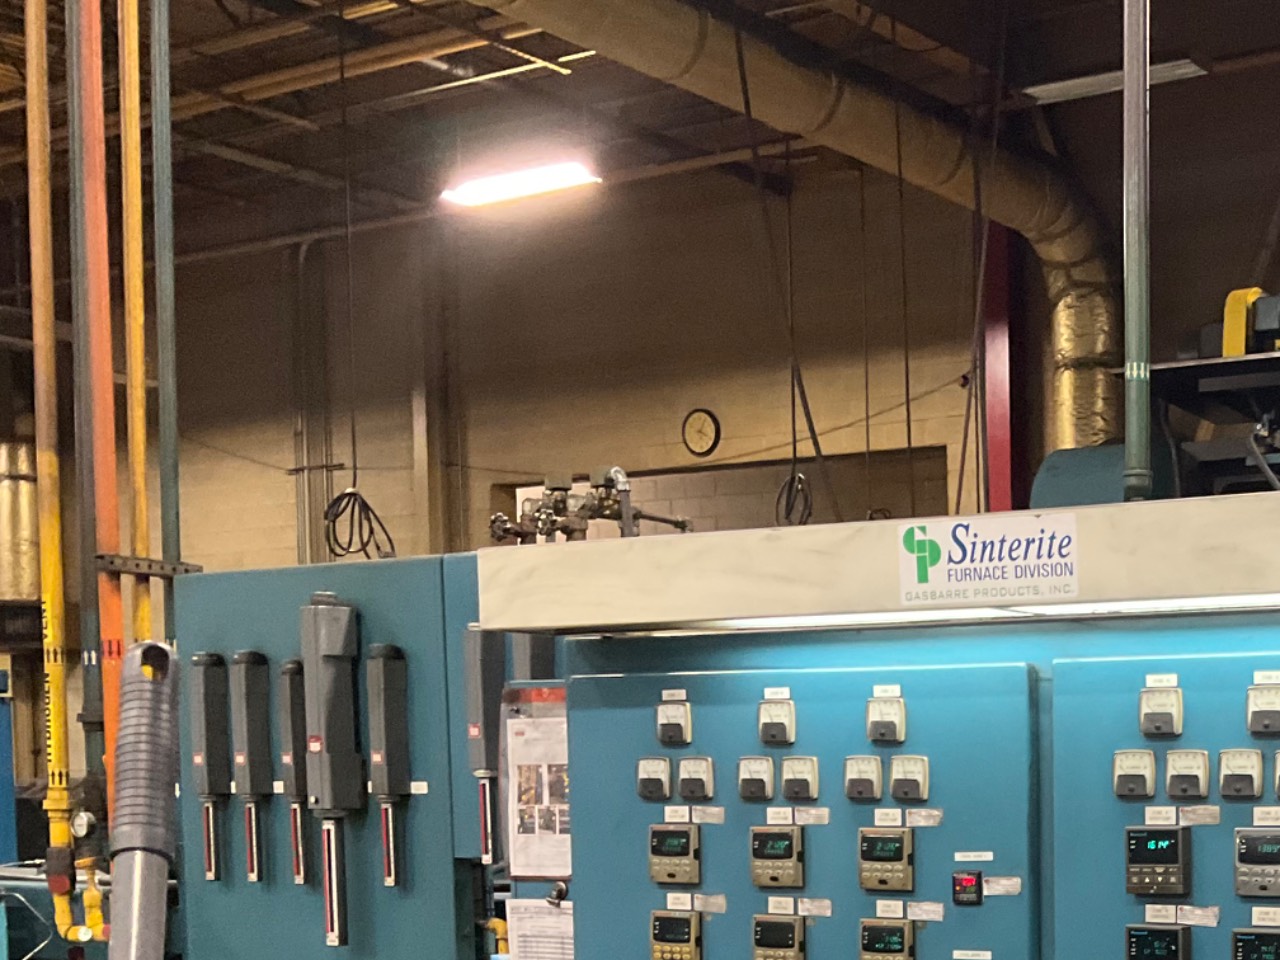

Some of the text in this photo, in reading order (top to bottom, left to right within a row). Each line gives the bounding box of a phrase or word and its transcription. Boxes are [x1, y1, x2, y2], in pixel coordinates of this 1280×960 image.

[947, 523, 1072, 565] Sinterite
[947, 562, 1074, 582] FURNACE DIVISION
[905, 583, 1074, 601] GASBARRE PRODUCTS, INC.
